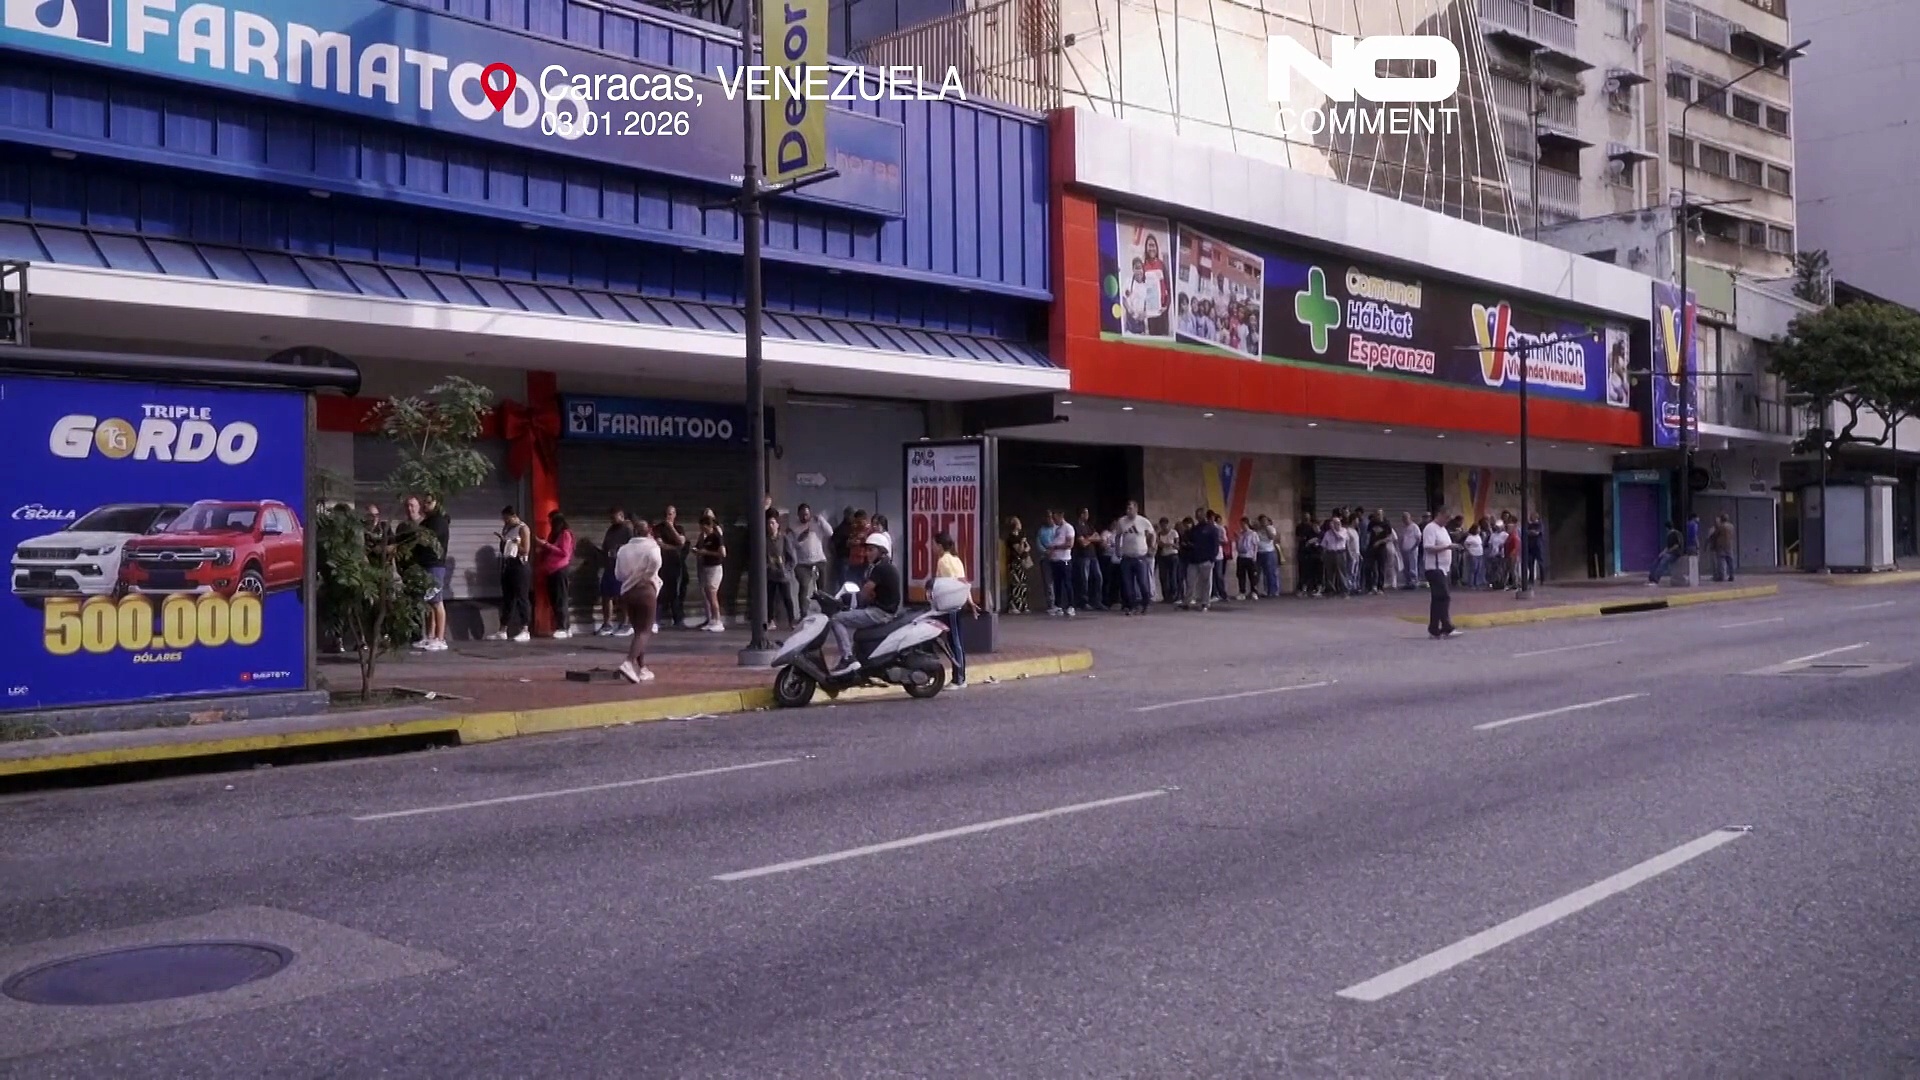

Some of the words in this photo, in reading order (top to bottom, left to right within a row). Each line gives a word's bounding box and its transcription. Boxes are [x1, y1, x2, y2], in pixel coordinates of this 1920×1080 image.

[127, 0, 590, 140] FARMATODO
[1346, 266, 1421, 308] Comunal
[1347, 300, 1413, 339] Hábitat
[1348, 333, 1435, 374] Esperanza
[142, 404, 211, 420] TRIPLE
[598, 413, 733, 440] FARMATODO
[911, 485, 938, 512] PERO
[942, 485, 976, 512] CAIGO
[911, 513, 975, 582] BIN
[43, 592, 262, 655] 500.000
